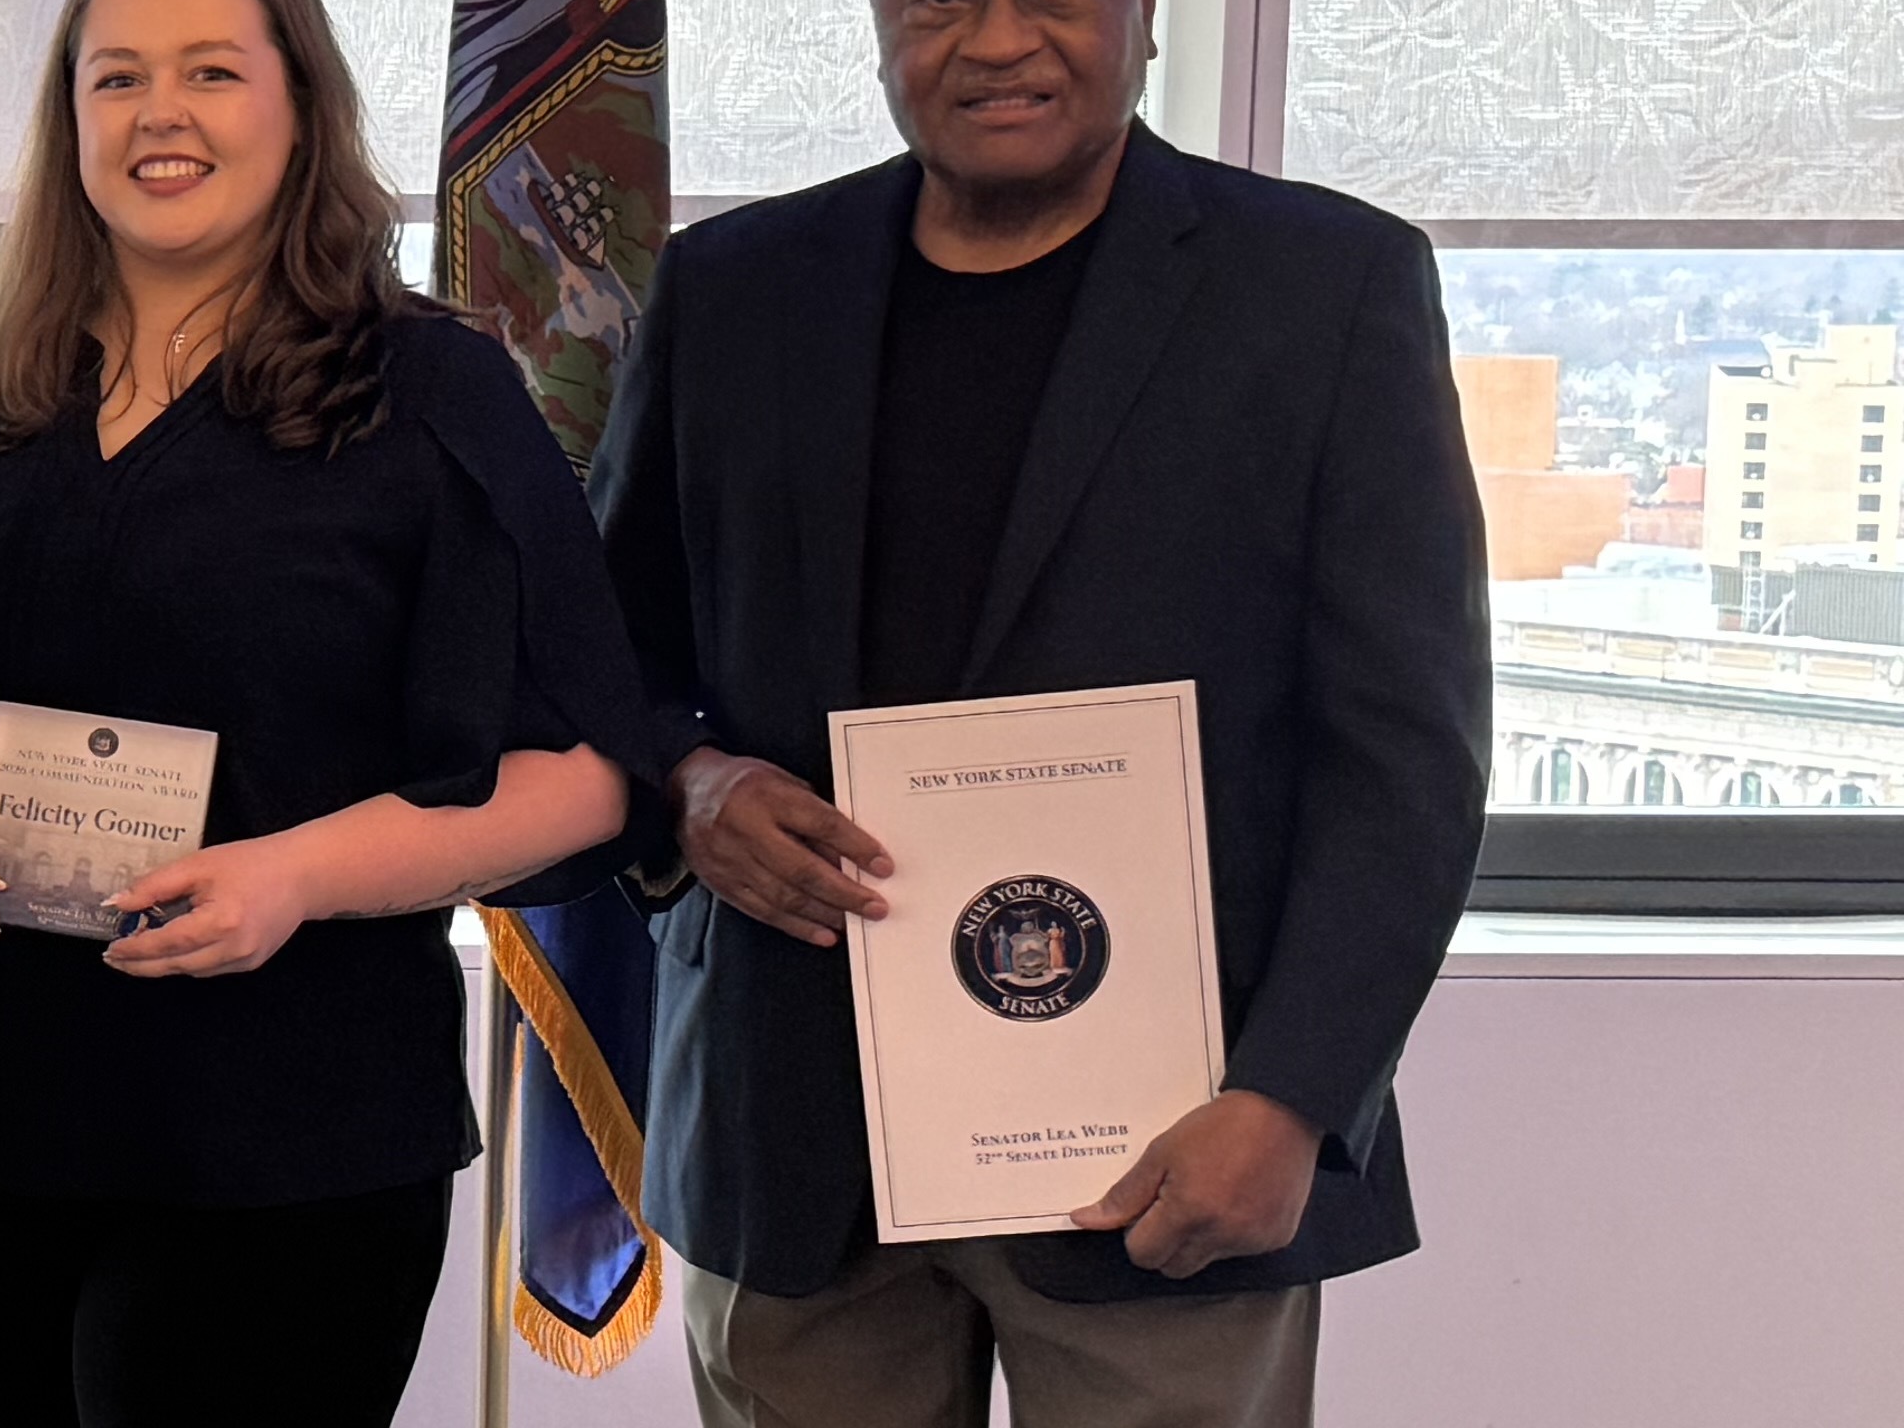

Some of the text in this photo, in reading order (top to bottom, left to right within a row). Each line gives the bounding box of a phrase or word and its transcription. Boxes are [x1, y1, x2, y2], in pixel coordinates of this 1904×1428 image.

[909, 759, 1127, 790] NEW YORK STATE SENATE
[94, 808, 186, 842] Gomer
[962, 882, 1098, 936] NEW YORK STATE
[999, 992, 1070, 1014] SENATE
